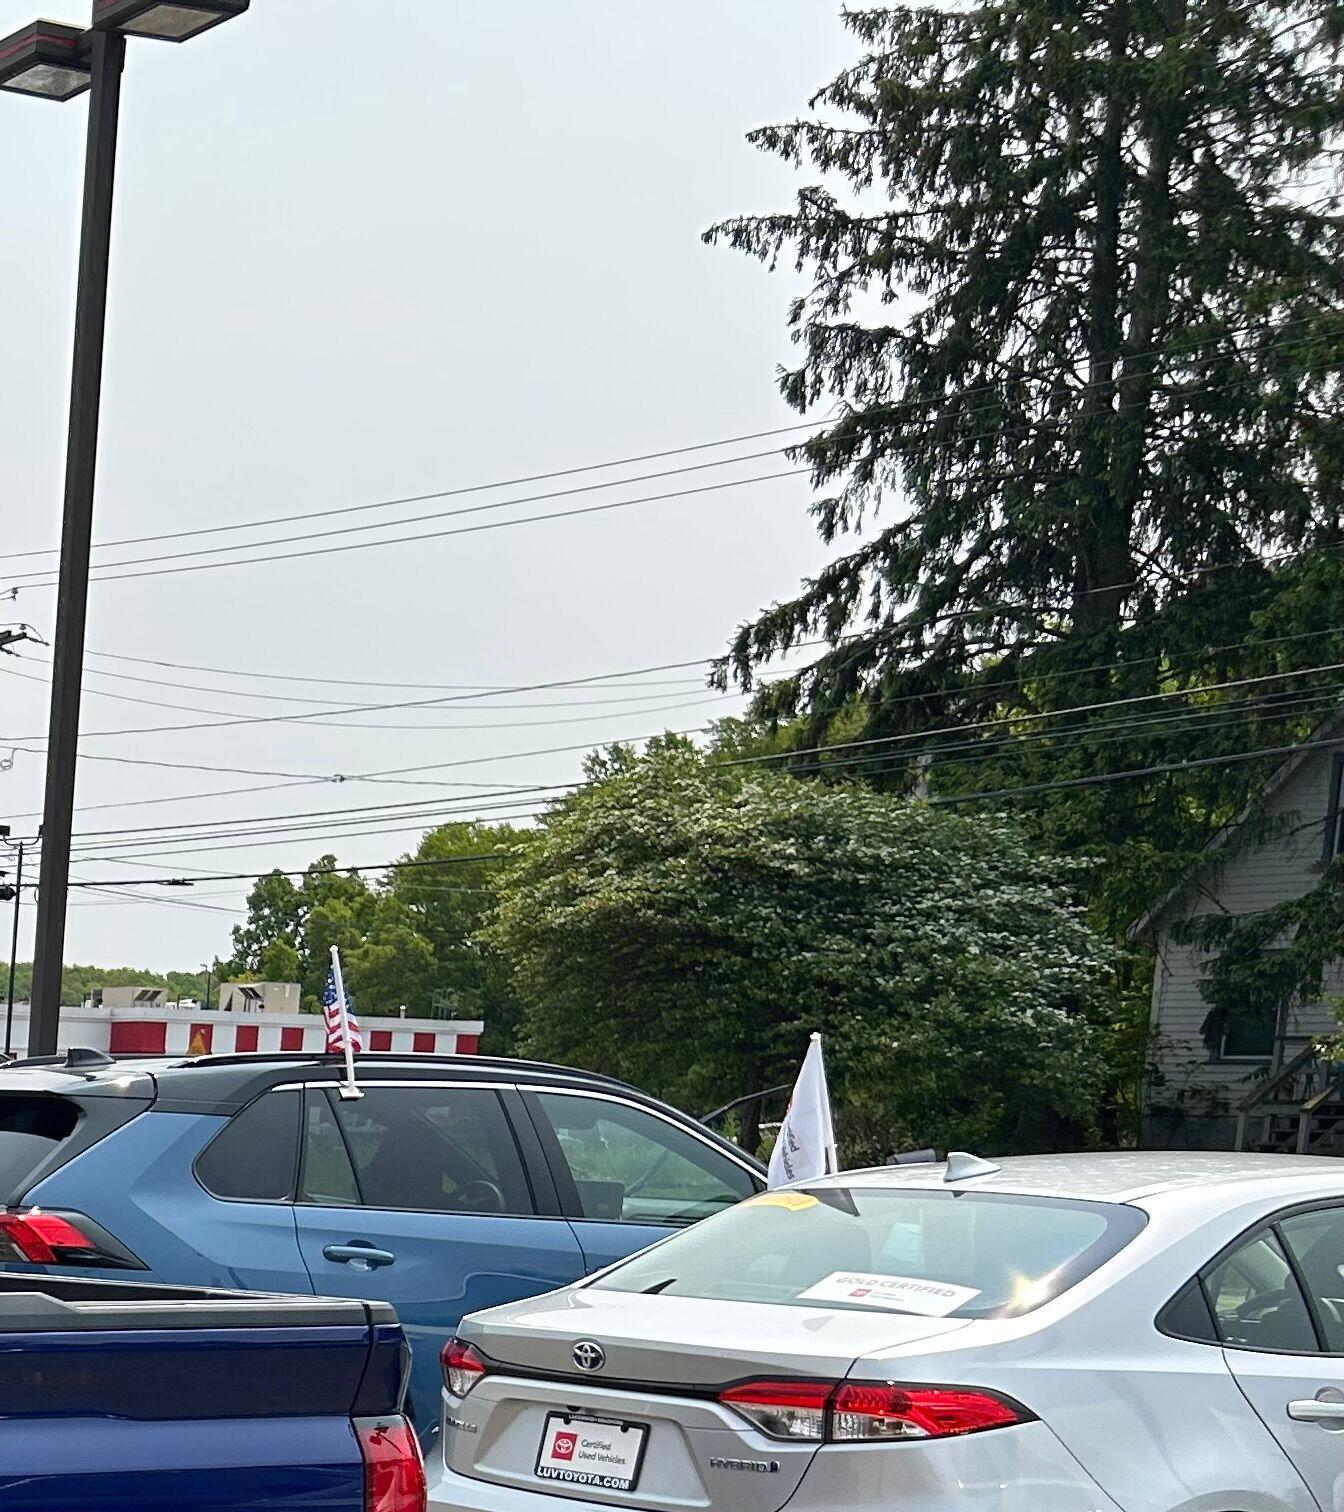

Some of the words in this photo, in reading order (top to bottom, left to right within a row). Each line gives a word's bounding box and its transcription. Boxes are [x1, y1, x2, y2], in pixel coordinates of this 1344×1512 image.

[836, 1276, 878, 1287] GOLD
[880, 1280, 957, 1298] CERTIFIED
[581, 1439, 612, 1451] Certified
[578, 1451, 597, 1460] Used
[598, 1453, 626, 1465] Vehicles
[709, 1457, 768, 1472] HYBRID
[537, 1466, 630, 1490] LUVTOYOTA.COM
